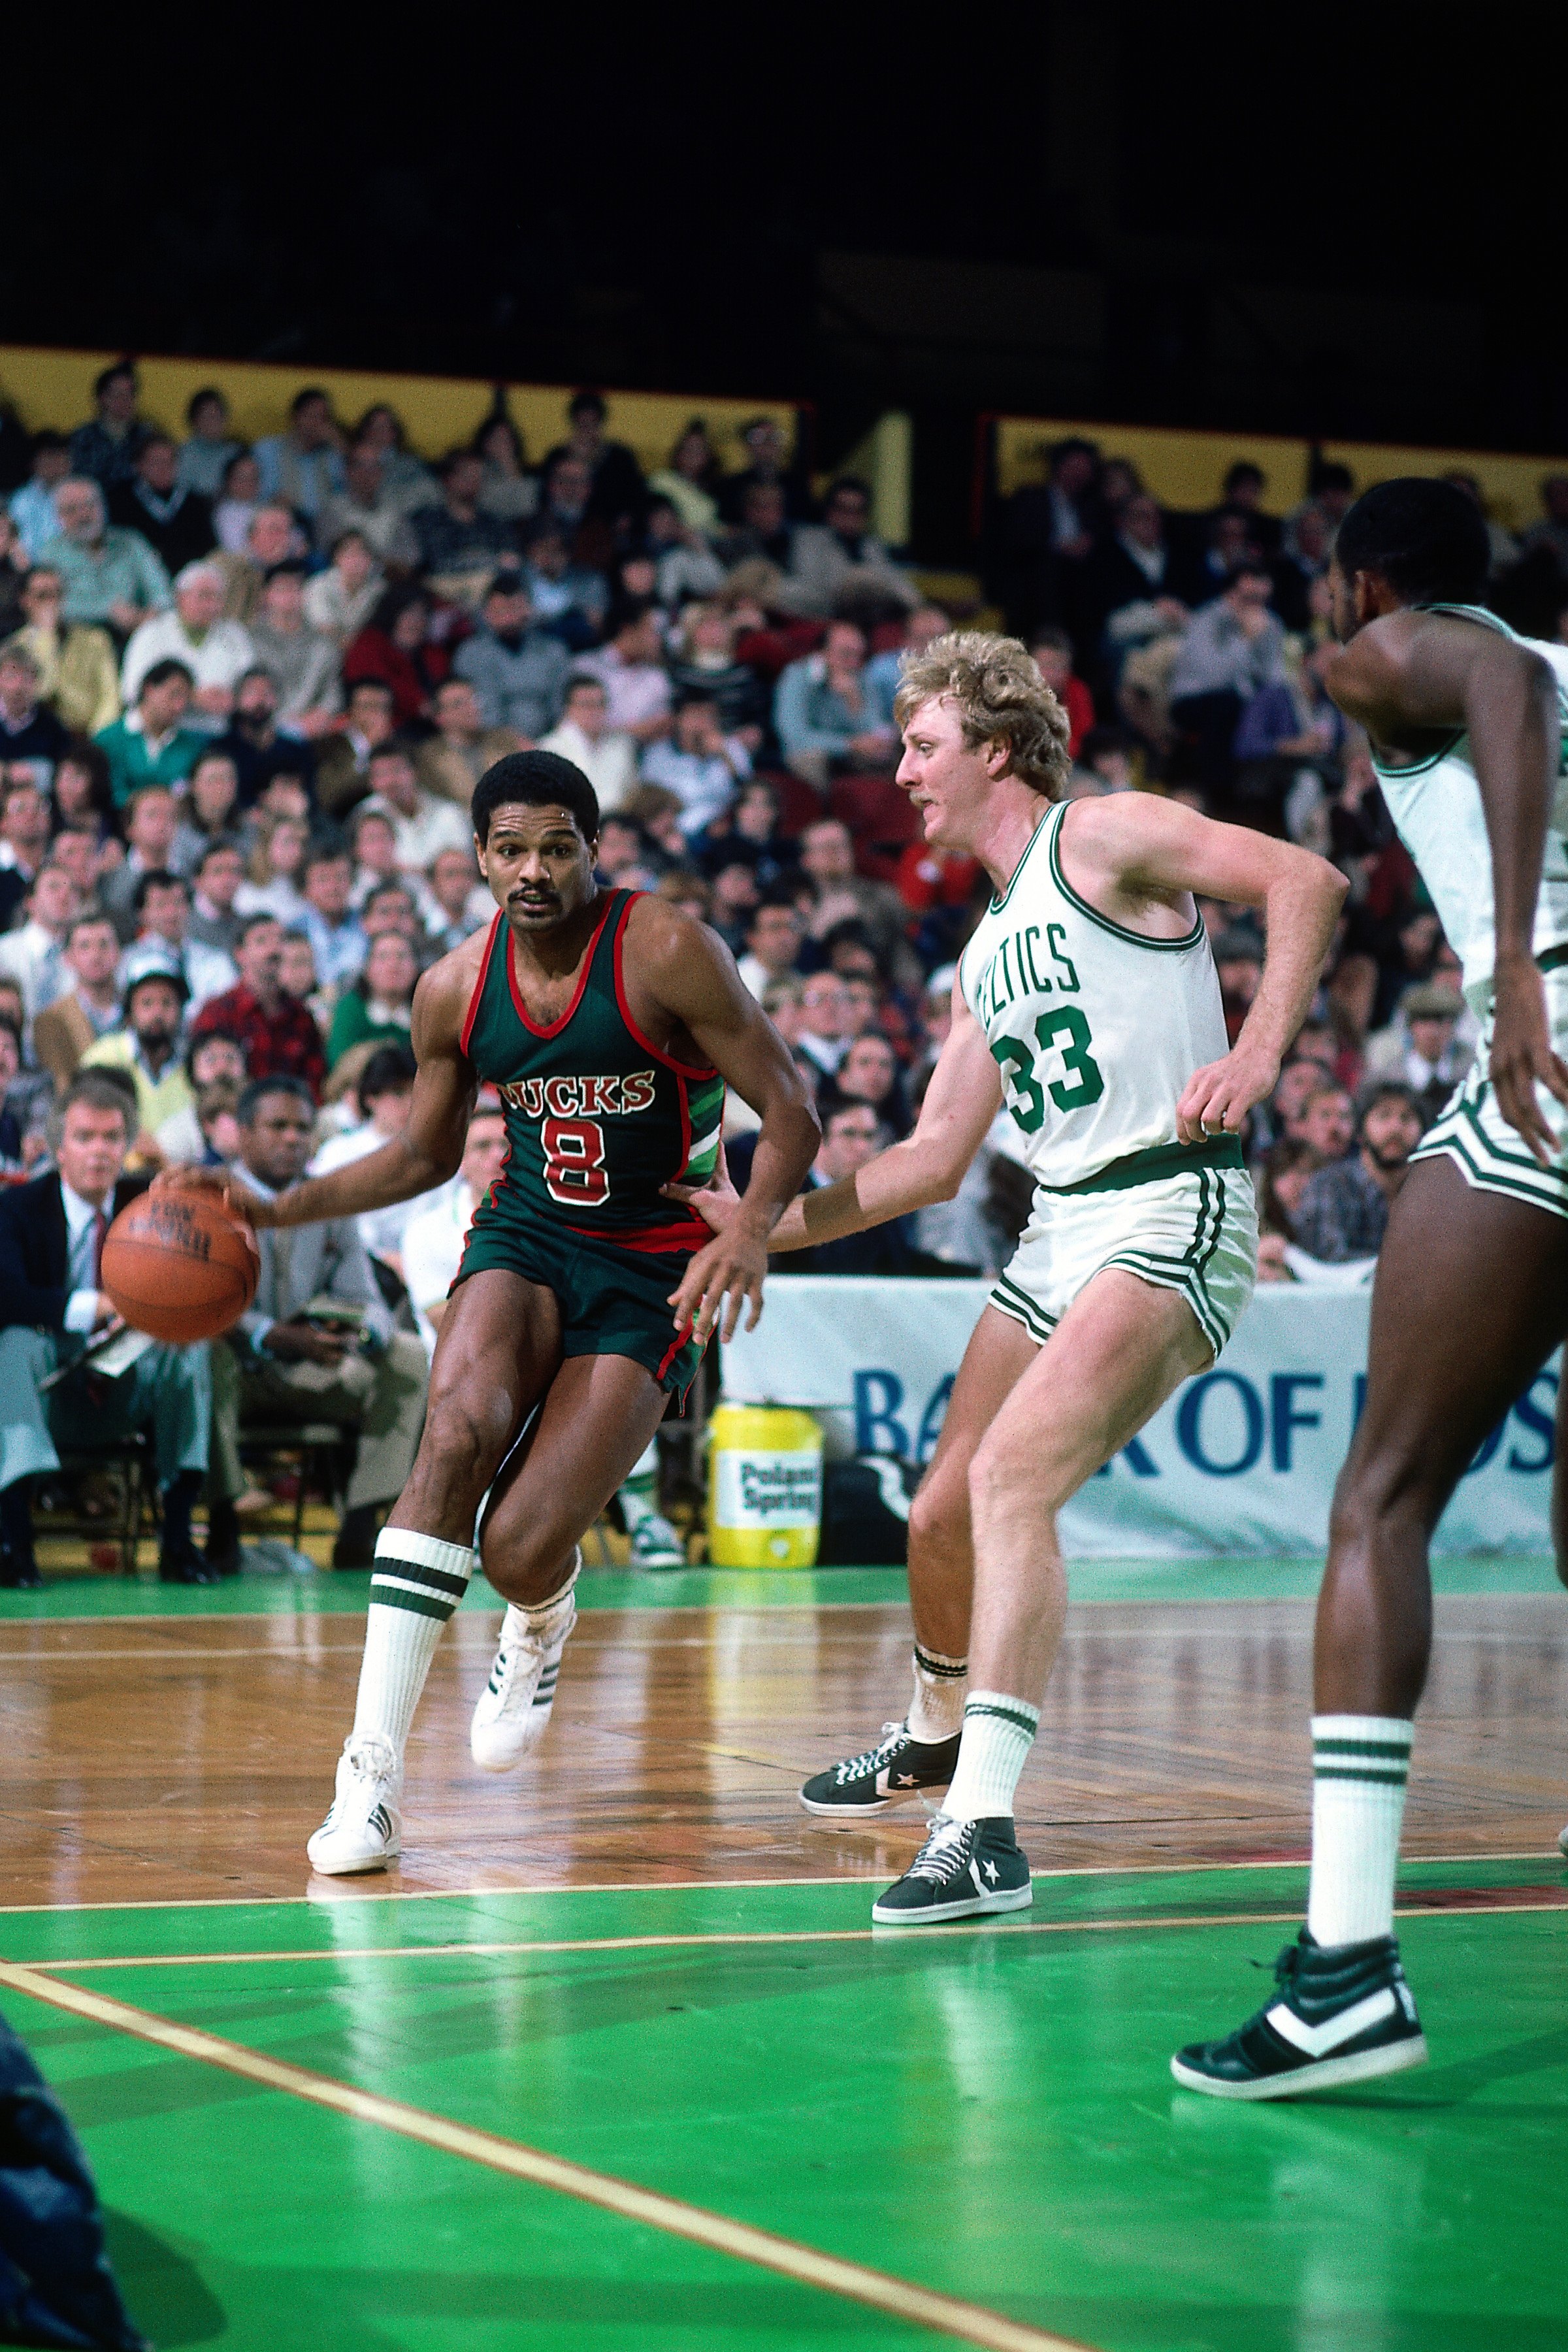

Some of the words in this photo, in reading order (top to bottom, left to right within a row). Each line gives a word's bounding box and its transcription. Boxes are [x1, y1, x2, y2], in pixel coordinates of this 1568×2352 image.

[990, 1005, 1104, 1135] 33
[541, 1117, 610, 1207] 8
[1176, 1367, 1324, 1477] OF
